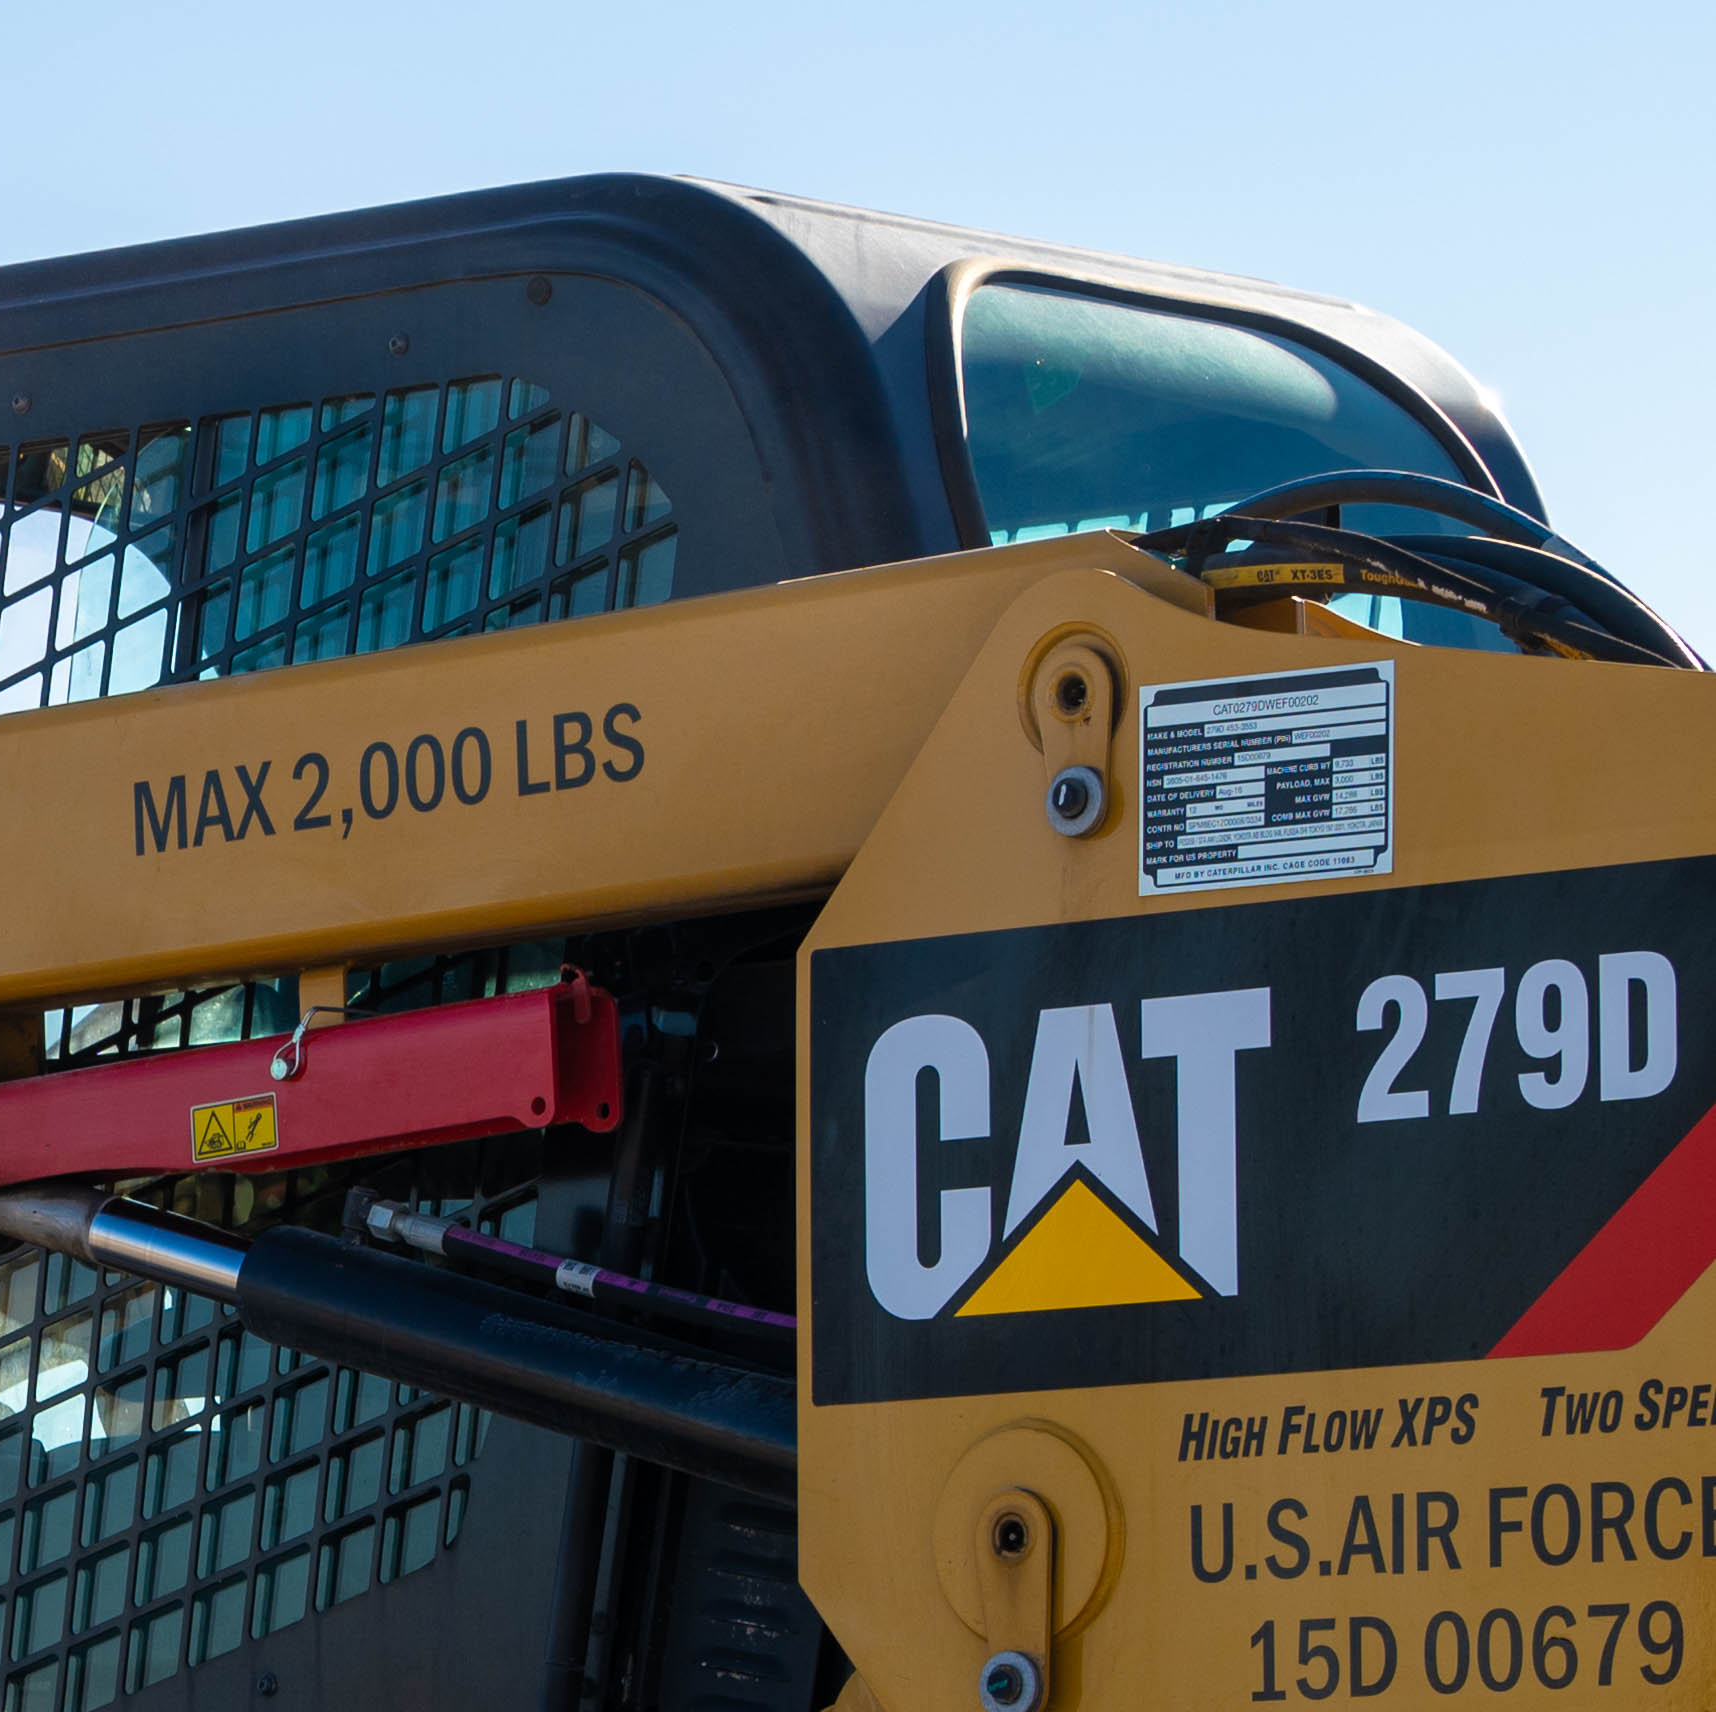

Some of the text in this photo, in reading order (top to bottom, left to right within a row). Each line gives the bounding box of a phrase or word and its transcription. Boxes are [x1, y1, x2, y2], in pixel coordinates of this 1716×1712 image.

[1177, 727, 1202, 737] MODEL
[1213, 739, 1238, 749] SERIAL
[134, 702, 645, 856] MAX 2,000 LBS
[1314, 777, 1329, 786] MAX
[1179, 788, 1214, 799] DELIVERY
[1295, 794, 1311, 803] MAX
[1147, 807, 1184, 818] WARRANTY
[1295, 810, 1311, 819] MAX
[1146, 824, 1172, 834] CONTR
[1197, 849, 1236, 860] PROPERTY
[1193, 870, 1203, 878] BY
[1206, 864, 1261, 877] CATERPILLAR
[1282, 860, 1304, 869] CAGE
[1308, 858, 1329, 867] CODE
[865, 951, 1678, 1320] CAT 279D
[1392, 1393, 1478, 1448] XPS
[1251, 1601, 1683, 1702] 15D 00679
